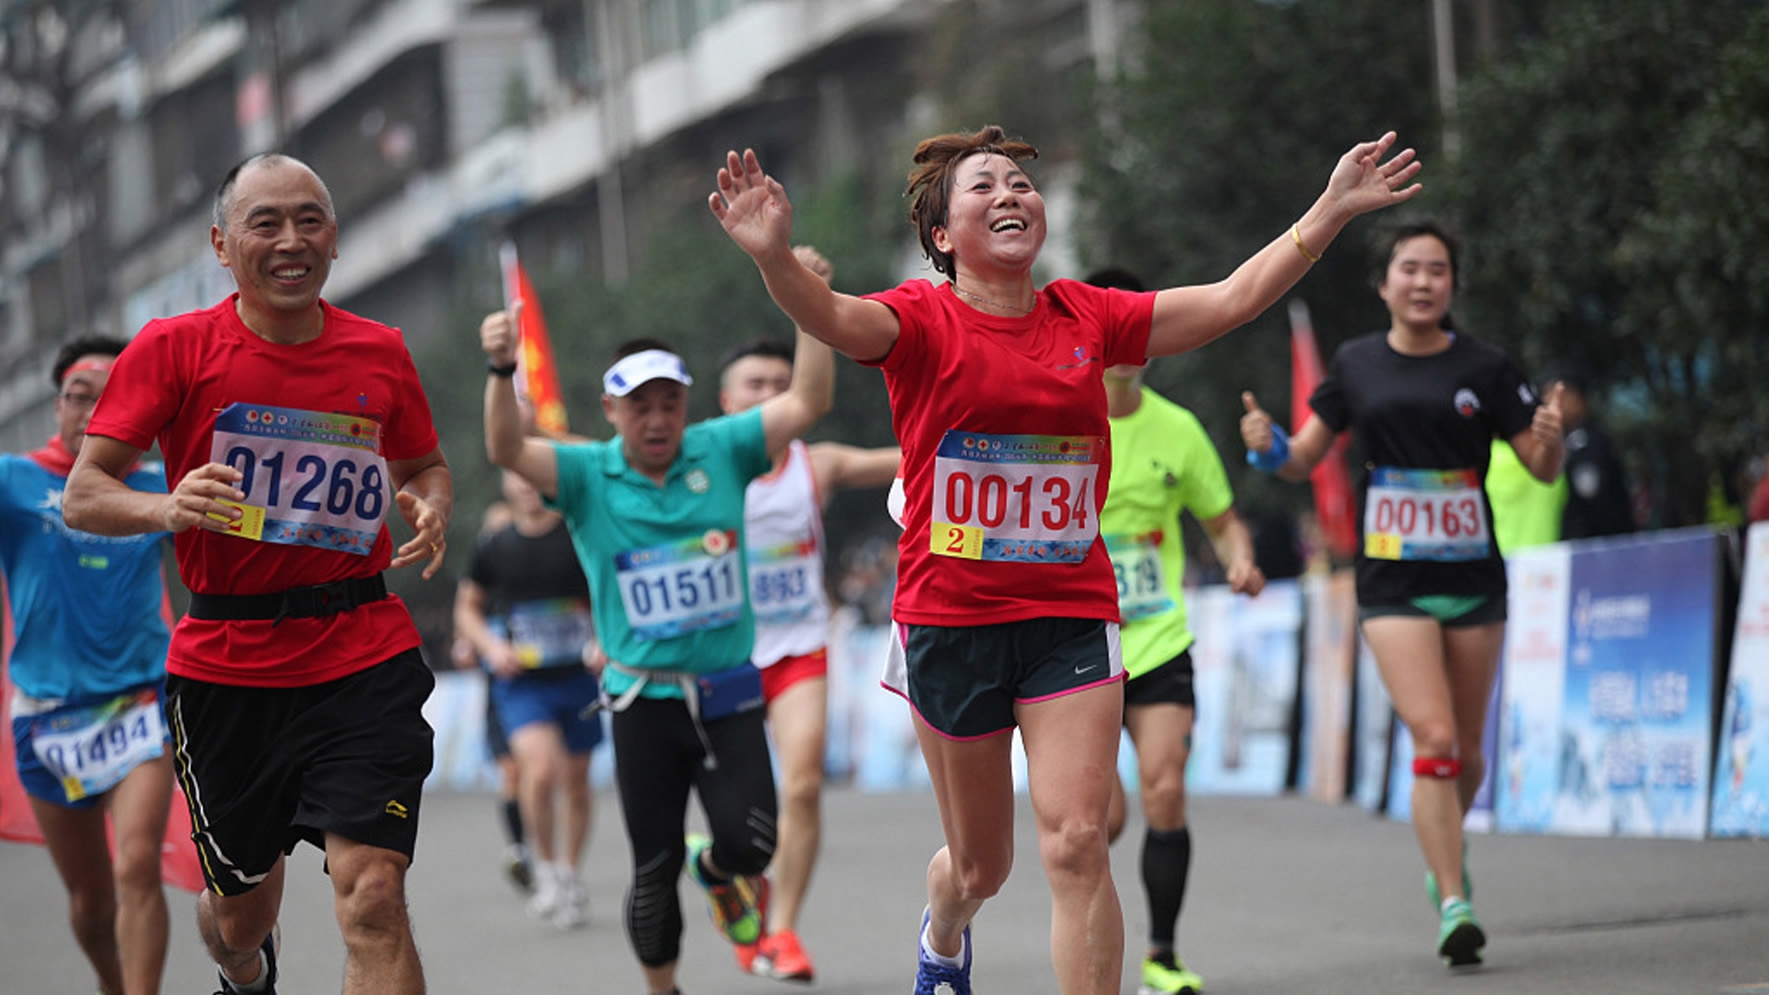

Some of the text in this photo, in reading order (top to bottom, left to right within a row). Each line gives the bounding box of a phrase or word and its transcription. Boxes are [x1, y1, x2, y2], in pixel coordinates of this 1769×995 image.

[226, 446, 383, 520] 01268
[945, 471, 1089, 531] 00134
[946, 528, 965, 553] 2
[1375, 497, 1480, 538] 00163
[630, 559, 734, 616] 01511
